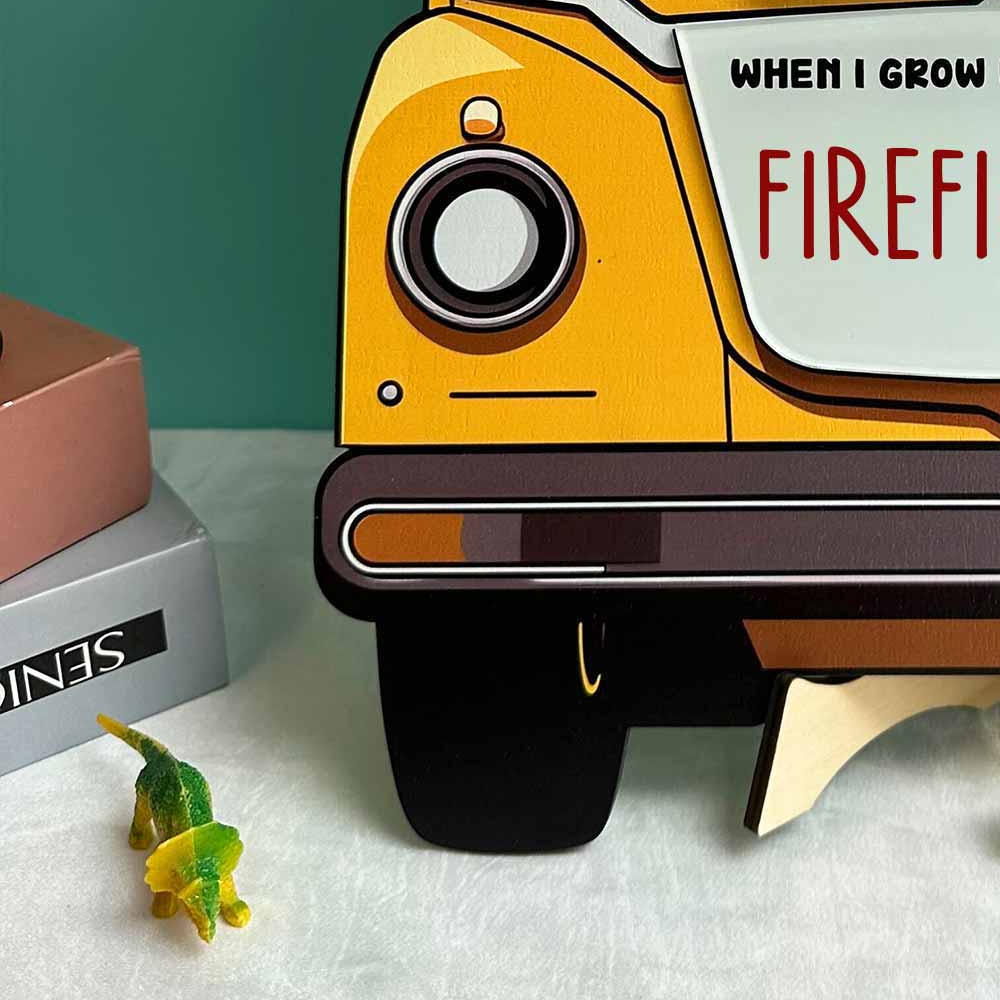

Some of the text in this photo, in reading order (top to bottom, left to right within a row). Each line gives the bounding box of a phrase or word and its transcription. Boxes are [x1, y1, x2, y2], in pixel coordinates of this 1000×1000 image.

[730, 57, 841, 90] WHEN
[854, 58, 865, 89] I
[879, 57, 985, 90] GROW
[0, 631, 125, 707] SENI
